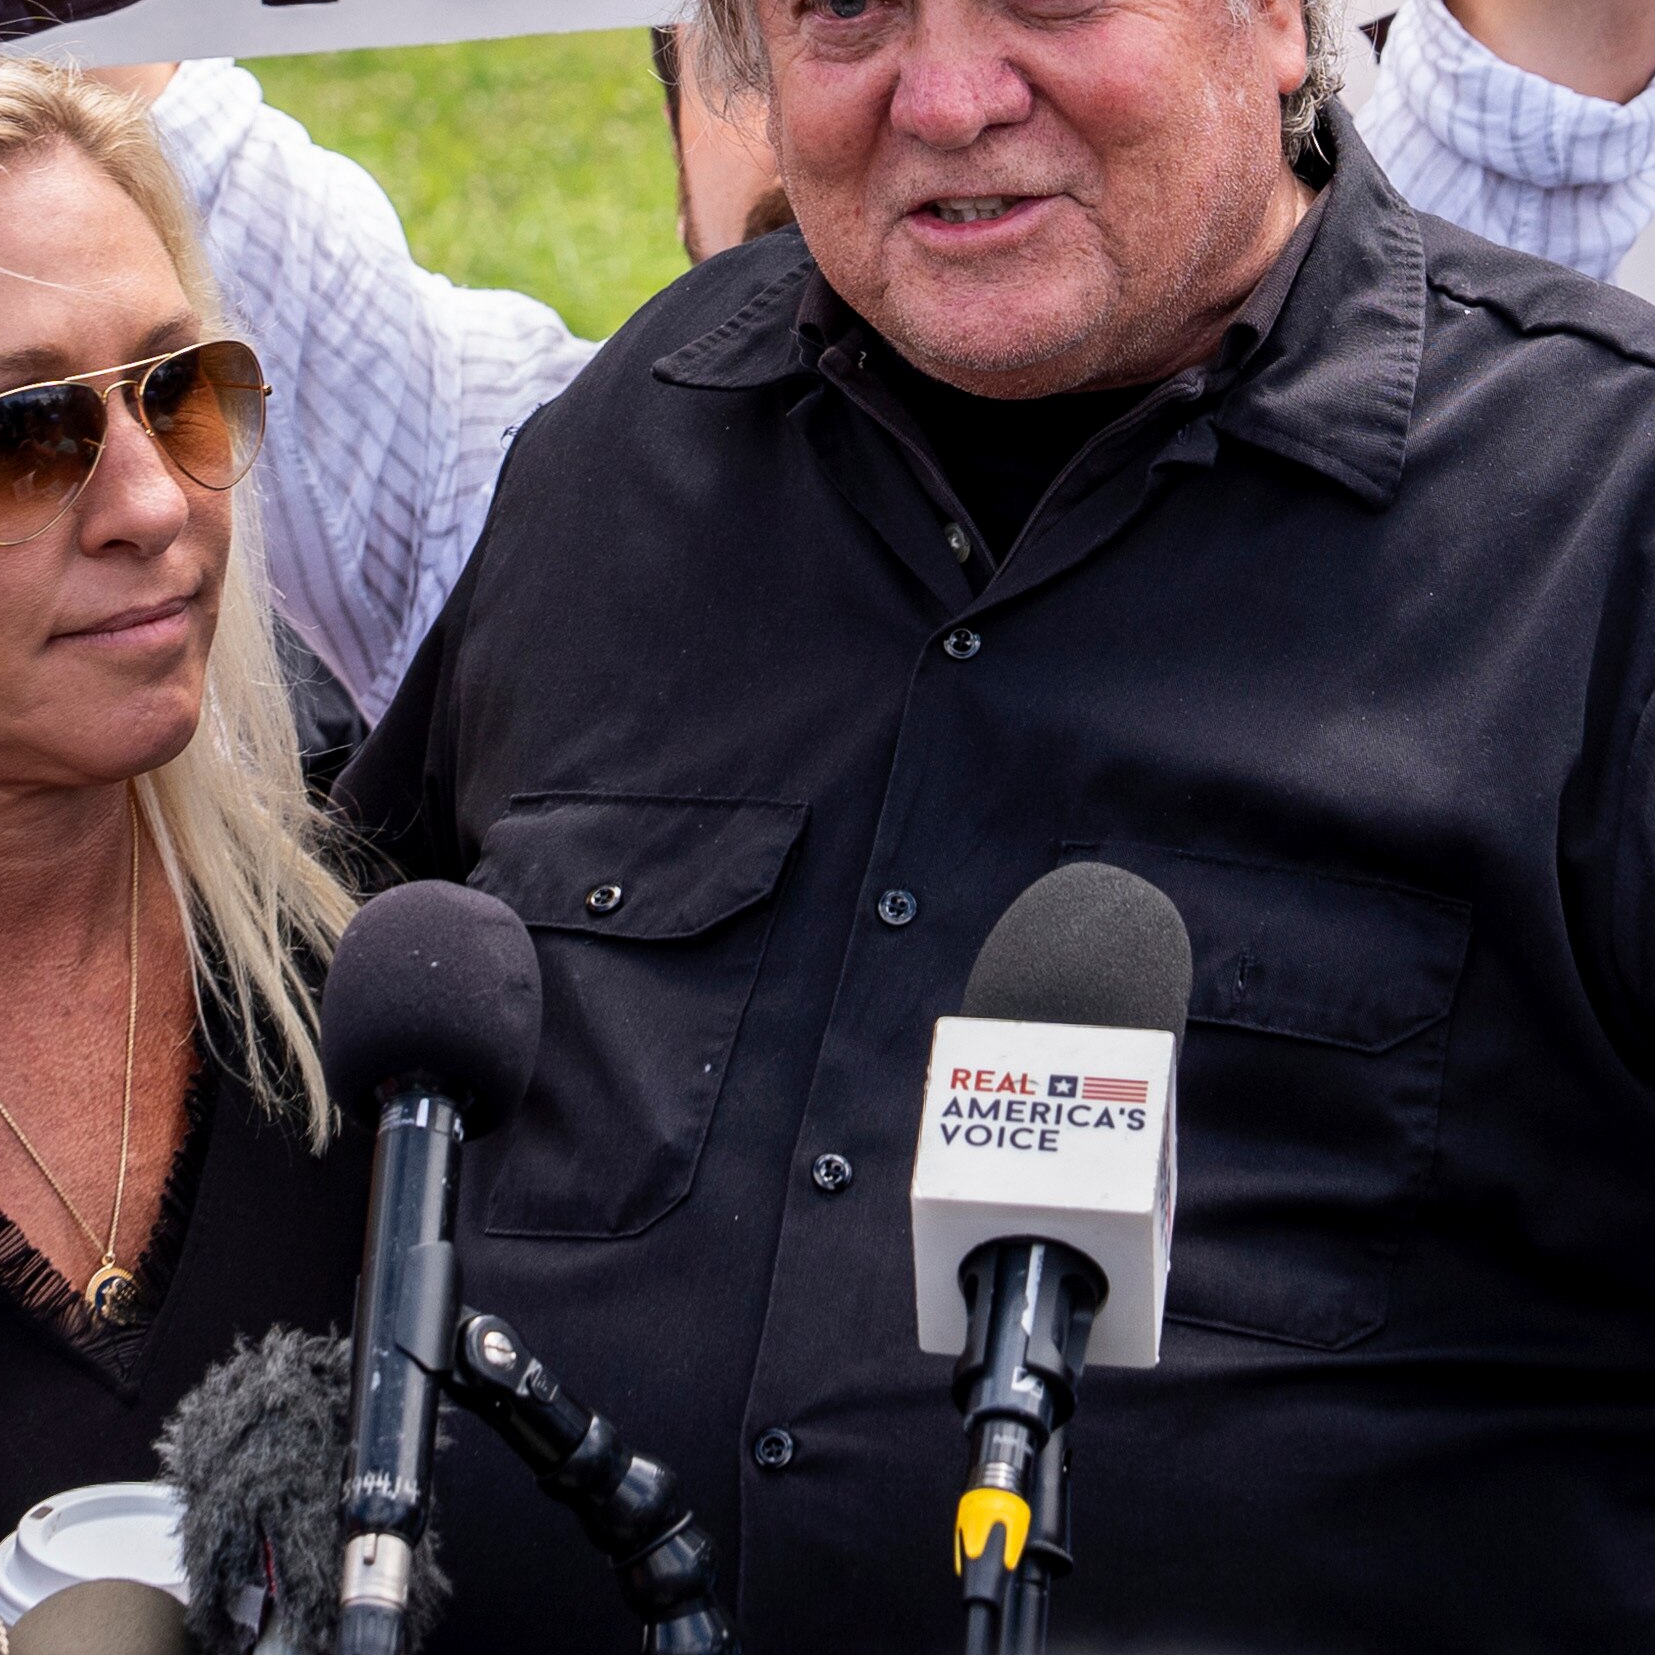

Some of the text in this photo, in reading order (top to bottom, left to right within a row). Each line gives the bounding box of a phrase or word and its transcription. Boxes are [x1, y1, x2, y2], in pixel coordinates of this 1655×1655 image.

[950, 1067, 1037, 1096] REAL
[941, 1095, 1147, 1132] AMERICA'S
[940, 1122, 1061, 1152] VOICE
